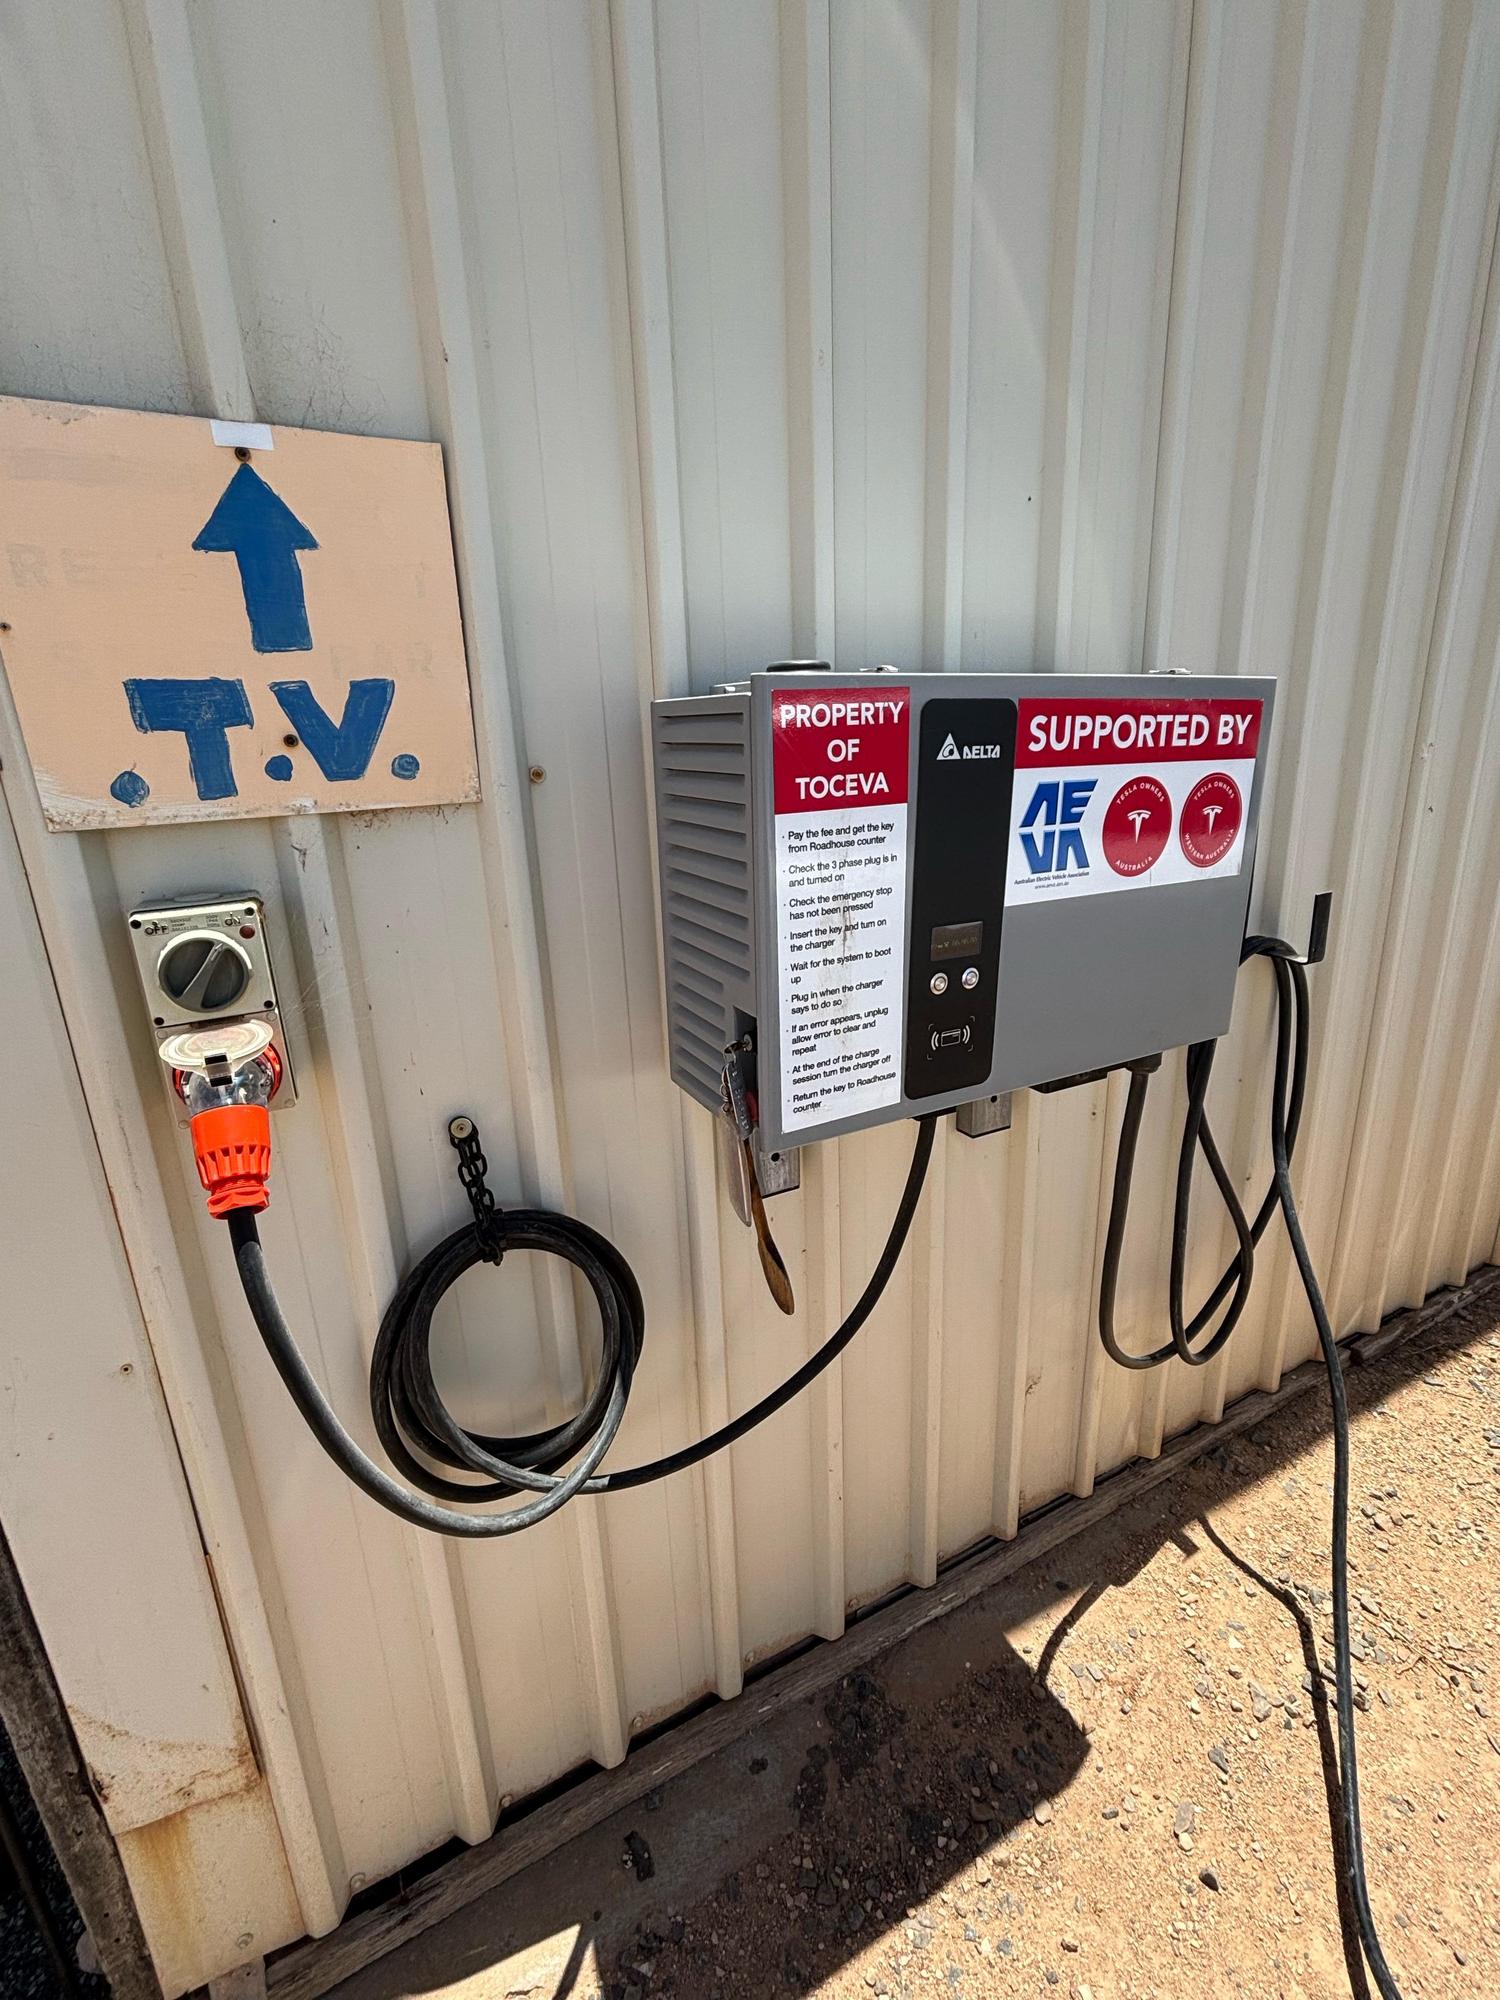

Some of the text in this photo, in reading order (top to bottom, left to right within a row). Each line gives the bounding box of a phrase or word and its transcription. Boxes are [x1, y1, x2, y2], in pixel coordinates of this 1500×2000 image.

[780, 702, 904, 728] PROPERTY
[1028, 713, 1253, 751] SUPPORTED BY
[827, 739, 860, 762] OF
[962, 744, 1000, 760] DELTA
[795, 772, 889, 799] TOCEVA
[1116, 783, 1165, 804] TESLA OWNERS
[1194, 781, 1234, 801] TESLA OWNERS
[788, 822, 894, 841] Pay the fee and get the key
[788, 836, 886, 853] from Roadhouse counter
[1185, 829, 1234, 860] WESTERN AUSTRALIA
[789, 864, 815, 874] Check
[817, 862, 830, 871] the
[832, 861, 836, 869] 3
[839, 858, 862, 869] phase
[864, 856, 880, 866] plug
[1116, 856, 1152, 871] AUSTRALIA
[789, 878, 804, 887] and
[807, 874, 833, 885] turned
[1014, 870, 1090, 885] Australian Electric Vehicle Association
[789, 887, 892, 907] Check the emergency stop
[790, 901, 873, 920] has not been pressed
[144, 926, 170, 936] OFF
[790, 930, 813, 940] Insert
[815, 928, 827, 936] the
[829, 925, 842, 935] key
[844, 922, 858, 931] and
[861, 920, 875, 929] turn
[790, 939, 835, 952] the charger
[791, 962, 808, 971] Wait
[810, 960, 821, 968] for
[823, 958, 835, 966] the
[837, 953, 863, 965] system
[874, 947, 891, 956] boot
[791, 976, 801, 985] up
[791, 979, 883, 1003] Plug in when the charger
[791, 1005, 809, 1015] says
[821, 1000, 831, 1008] do
[792, 1007, 889, 1033] If an error appears, unplug
[792, 1034, 812, 1044] allow
[814, 1030, 831, 1039] error
[843, 1023, 861, 1034] clear
[862, 1021, 876, 1029] and
[792, 1045, 817, 1056] repeat
[792, 1048, 880, 1074] At the end of the charge
[792, 1055, 891, 1085] session turn the charger off
[793, 1072, 896, 1103] Return the key to Roadhouse
[793, 1101, 822, 1114] counter
